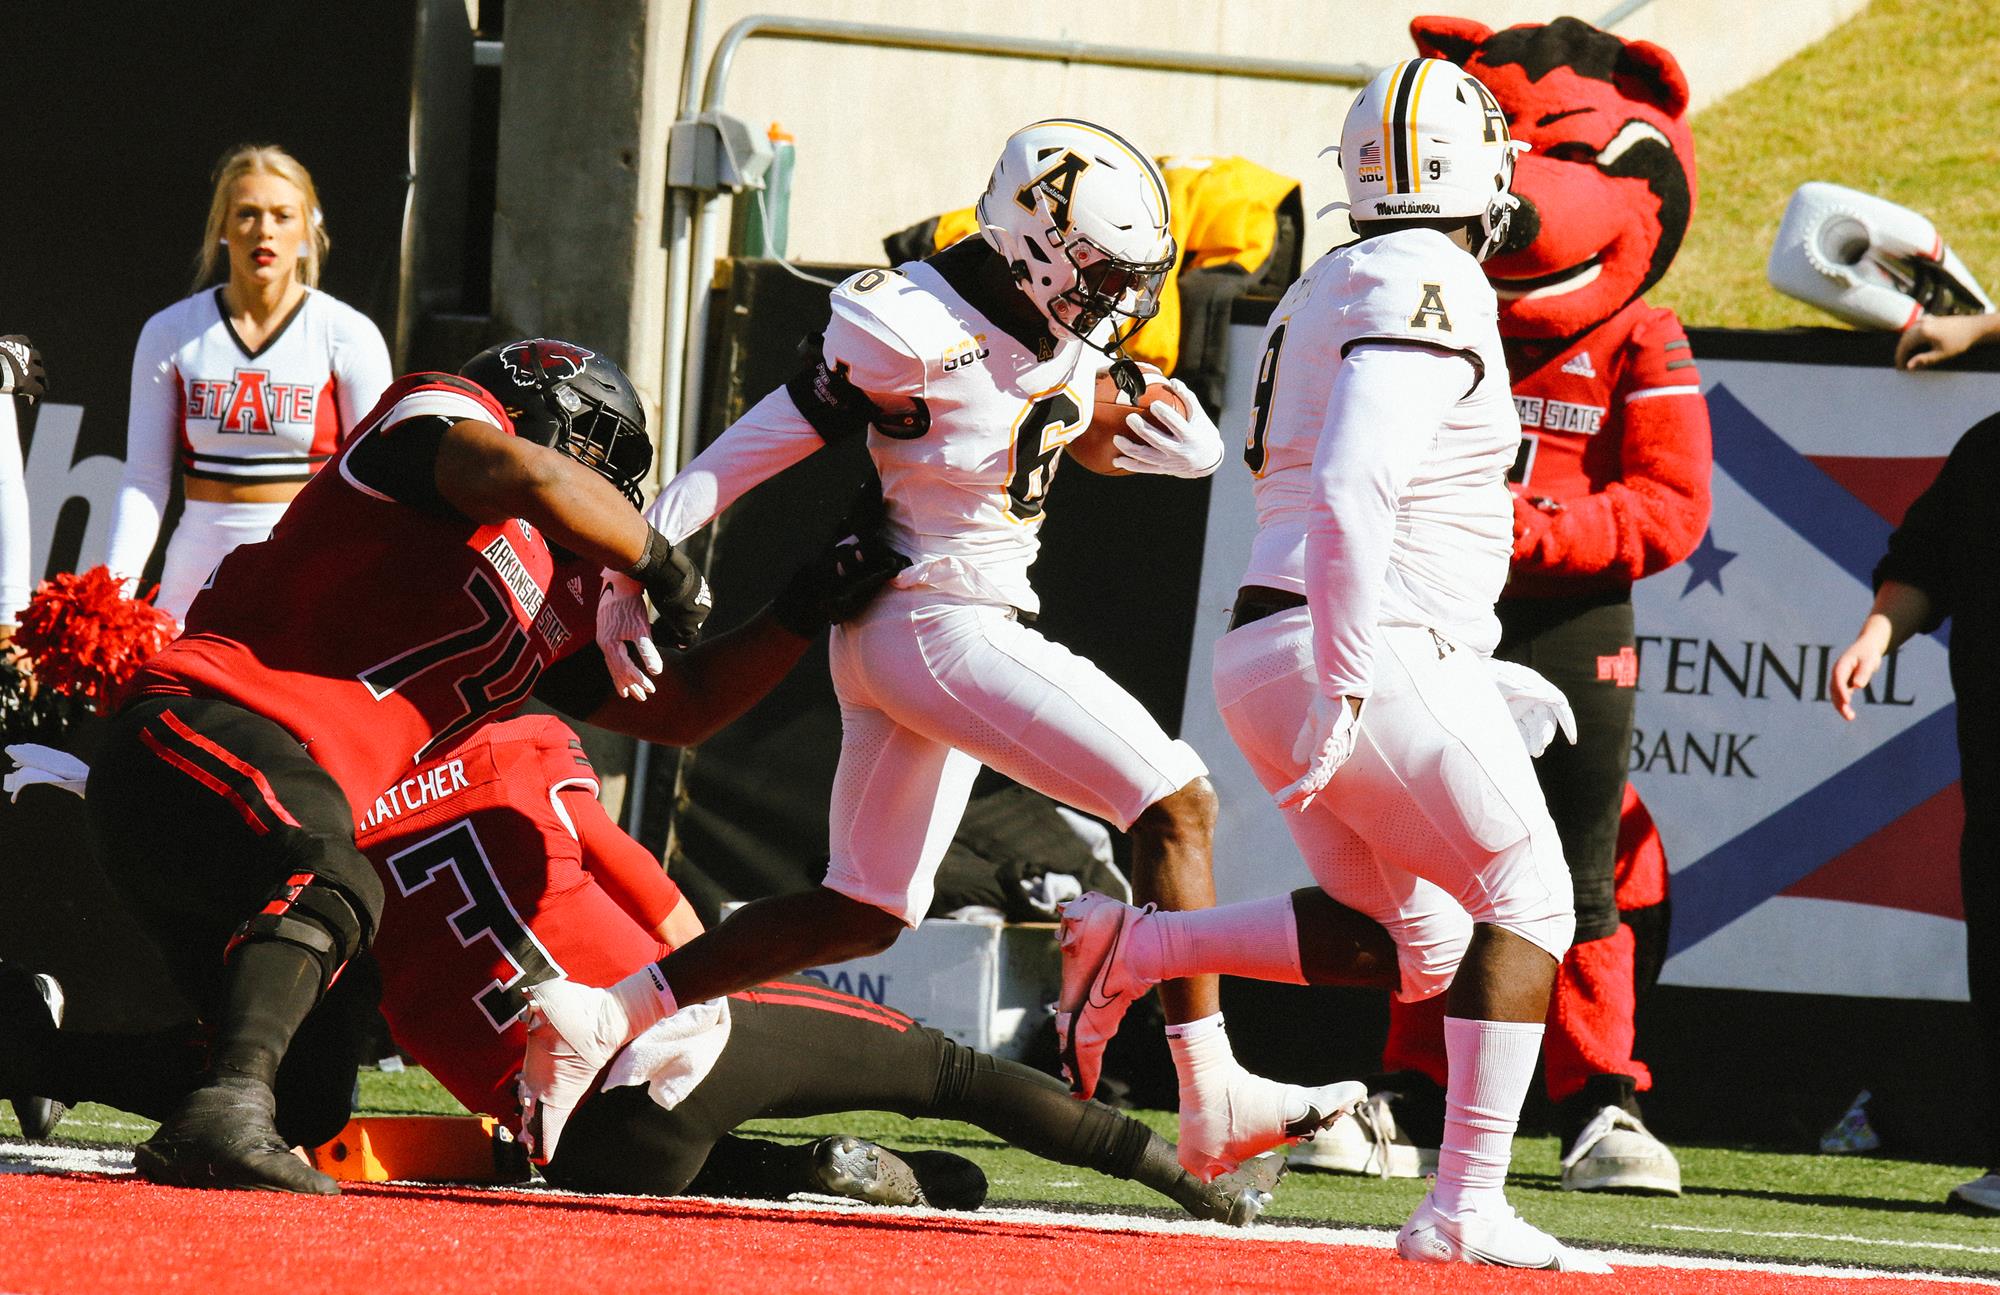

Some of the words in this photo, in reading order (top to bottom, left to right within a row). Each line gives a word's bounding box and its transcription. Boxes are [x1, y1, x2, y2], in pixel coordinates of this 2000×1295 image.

[1014, 148, 1093, 236] A
[1358, 165, 1385, 183] SBC
[1429, 160, 1441, 180] 9
[1373, 200, 1441, 217] Mountaineers
[1408, 281, 1453, 333] A
[943, 333, 990, 372] SBC
[186, 367, 314, 436] STATE
[1243, 314, 1291, 480] 9
[1545, 401, 1603, 435] STATE
[1000, 382, 1084, 526] 6
[483, 535, 545, 620] ARKANSAS
[1635, 635, 1916, 707] TENNIL
[386, 818, 569, 1034] 3
